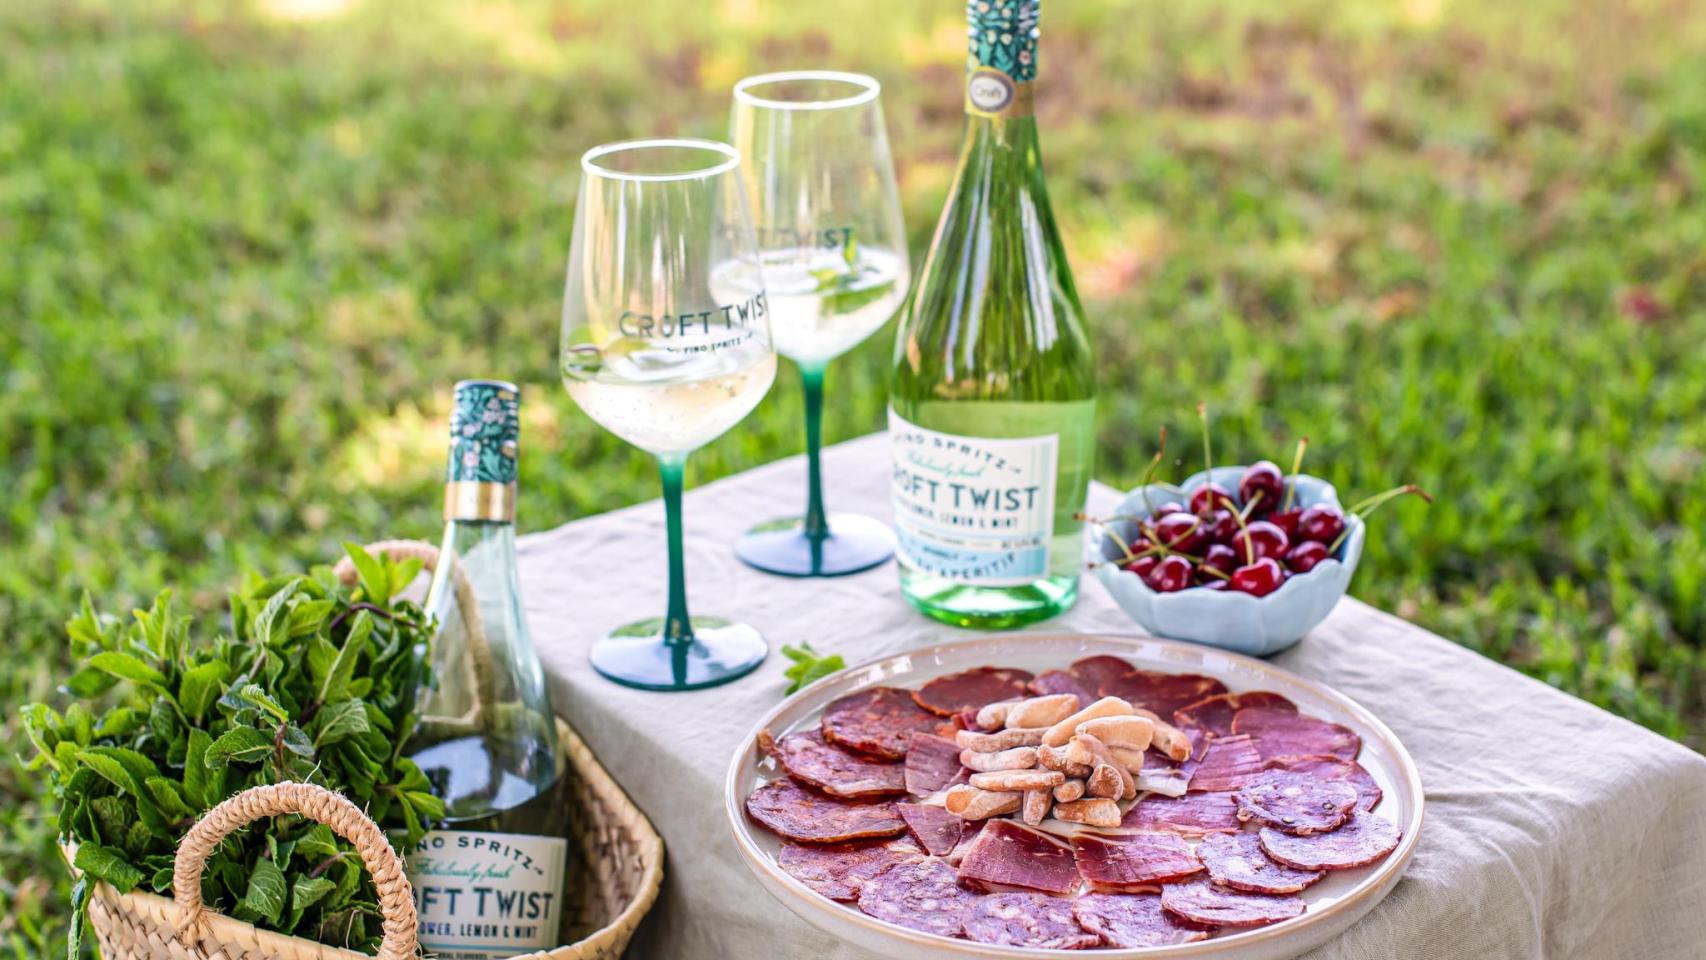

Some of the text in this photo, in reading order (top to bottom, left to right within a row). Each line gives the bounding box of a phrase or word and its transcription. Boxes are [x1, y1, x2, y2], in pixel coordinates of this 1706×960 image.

[619, 311, 713, 338] CROFT
[684, 345, 708, 354] FINO
[933, 438, 1007, 470] SPRITZ
[949, 483, 1040, 512] TWIST
[416, 835, 534, 870] NO SPRITZ
[415, 887, 555, 921] FT TWIST
[419, 922, 455, 937] OWER,
[460, 924, 498, 938] LEMON
[514, 926, 539, 939] MINT
